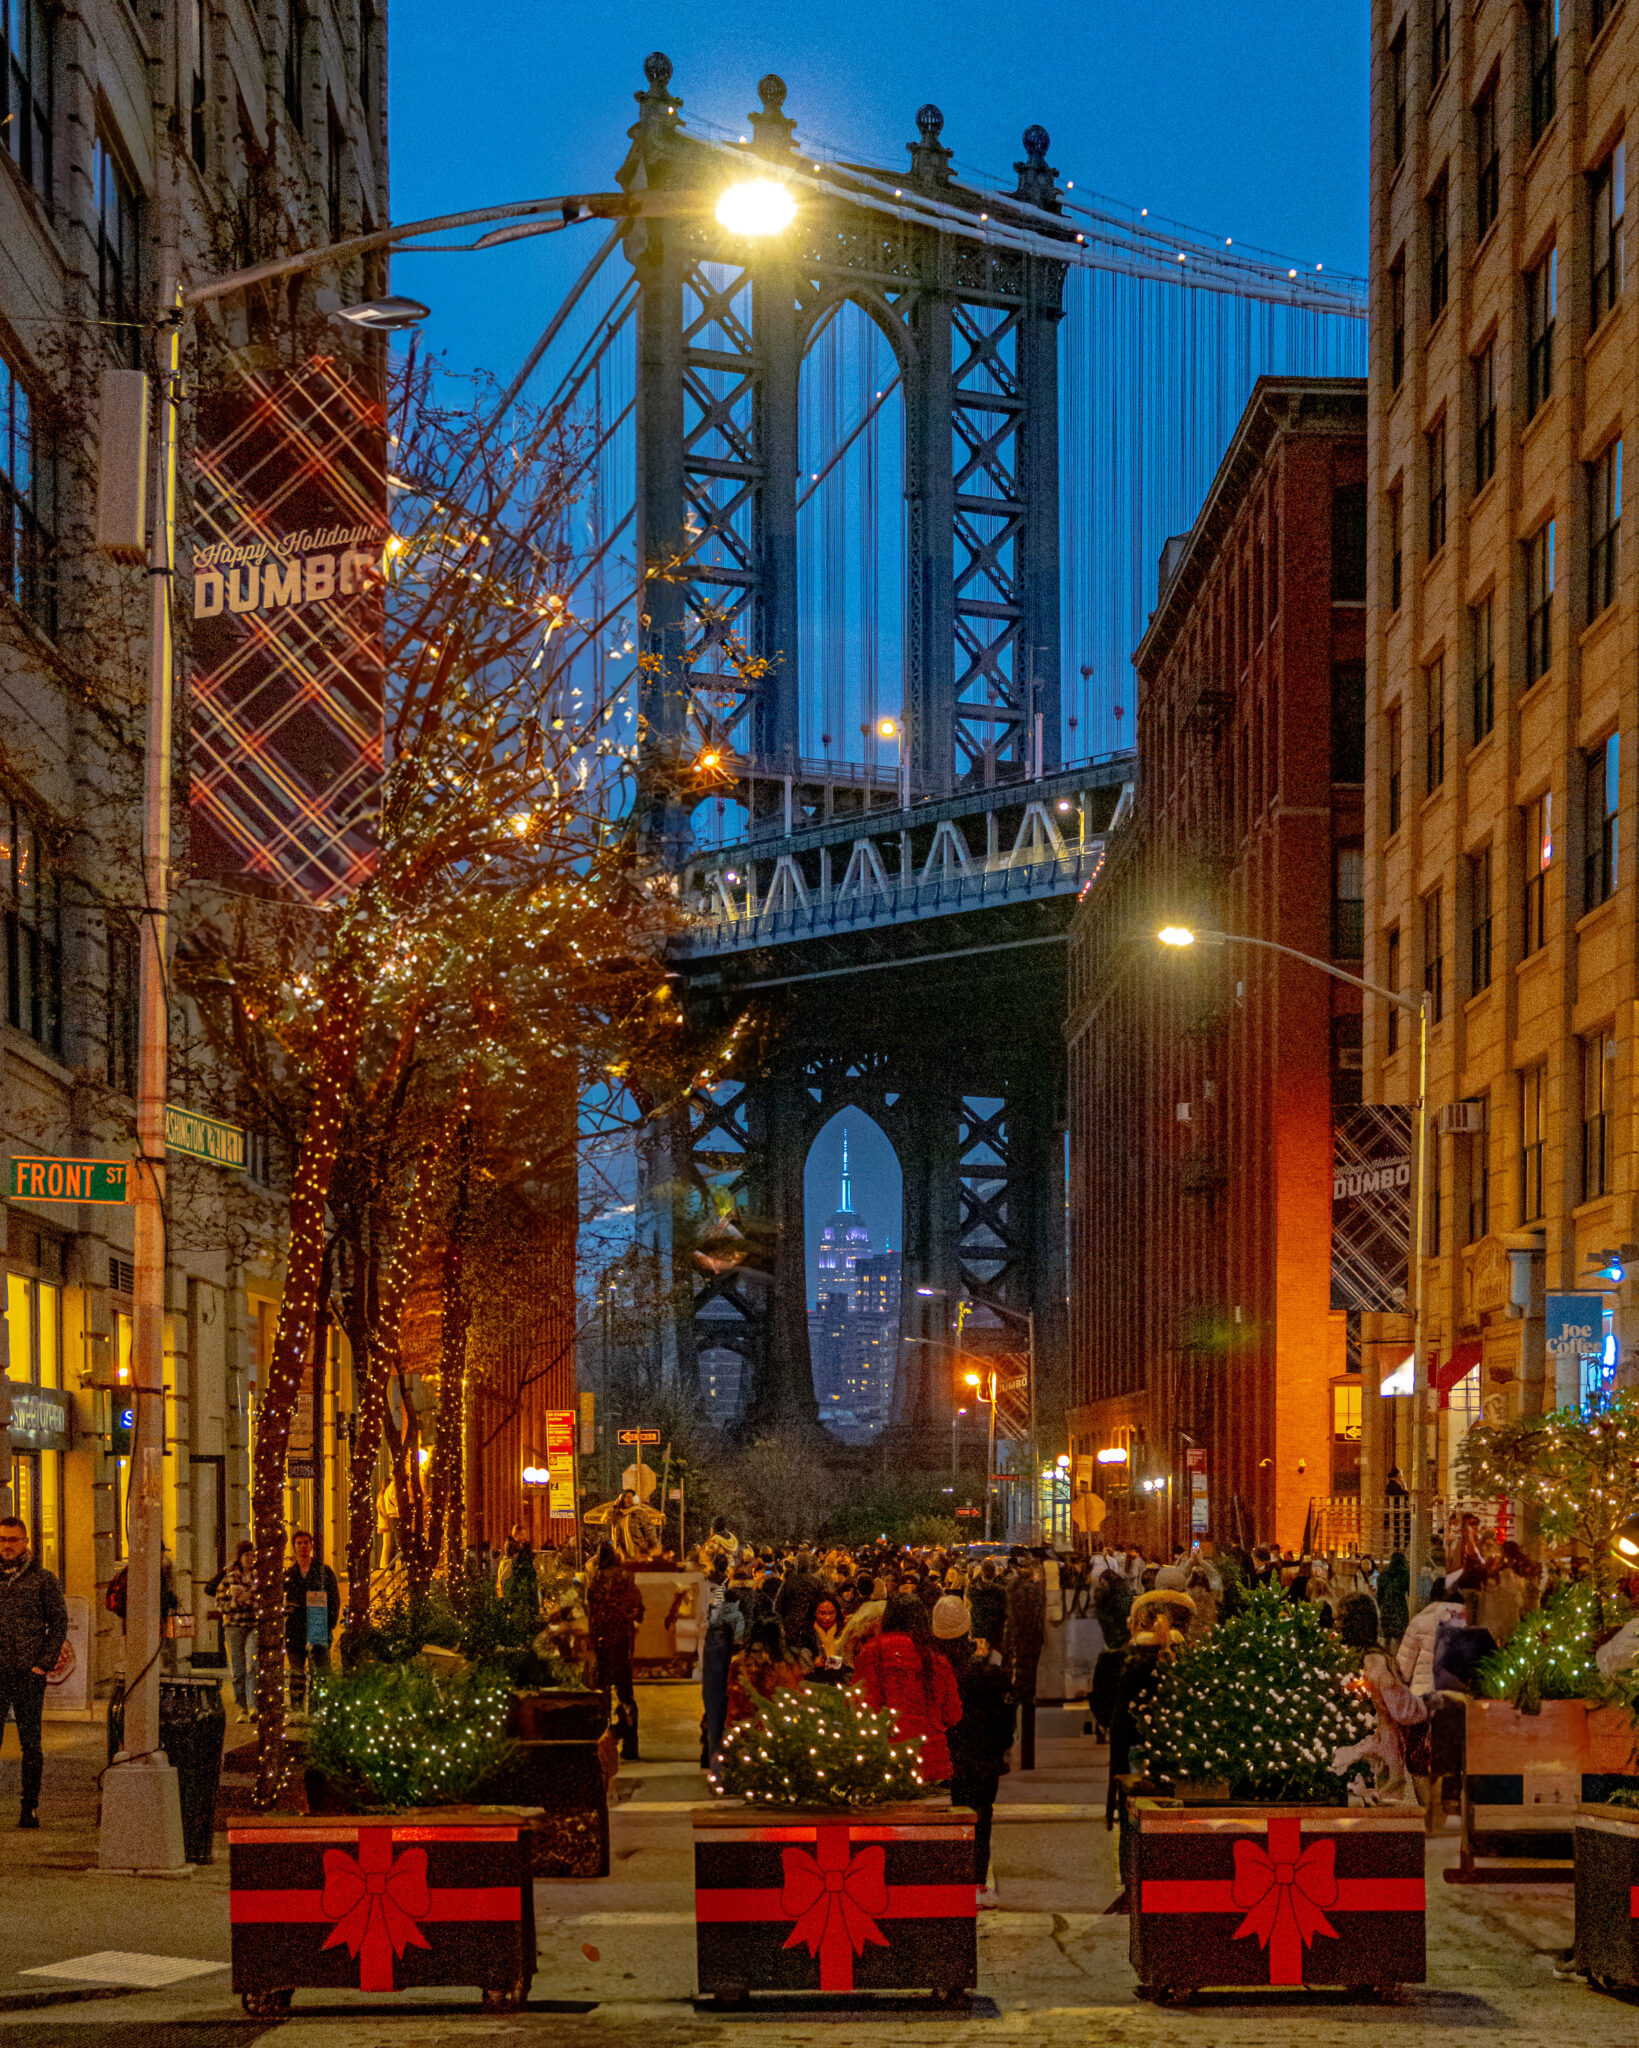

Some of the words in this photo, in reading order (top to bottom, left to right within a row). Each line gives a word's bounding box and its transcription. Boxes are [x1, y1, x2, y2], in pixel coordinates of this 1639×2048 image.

[193, 540, 270, 569] Happy
[16, 1162, 95, 1197] FRONT
[106, 1167, 124, 1184] ST
[1334, 1164, 1410, 1200] DUMBO
[1545, 1337, 1602, 1354] Coffee
[1558, 1323, 1592, 1341] Joe
